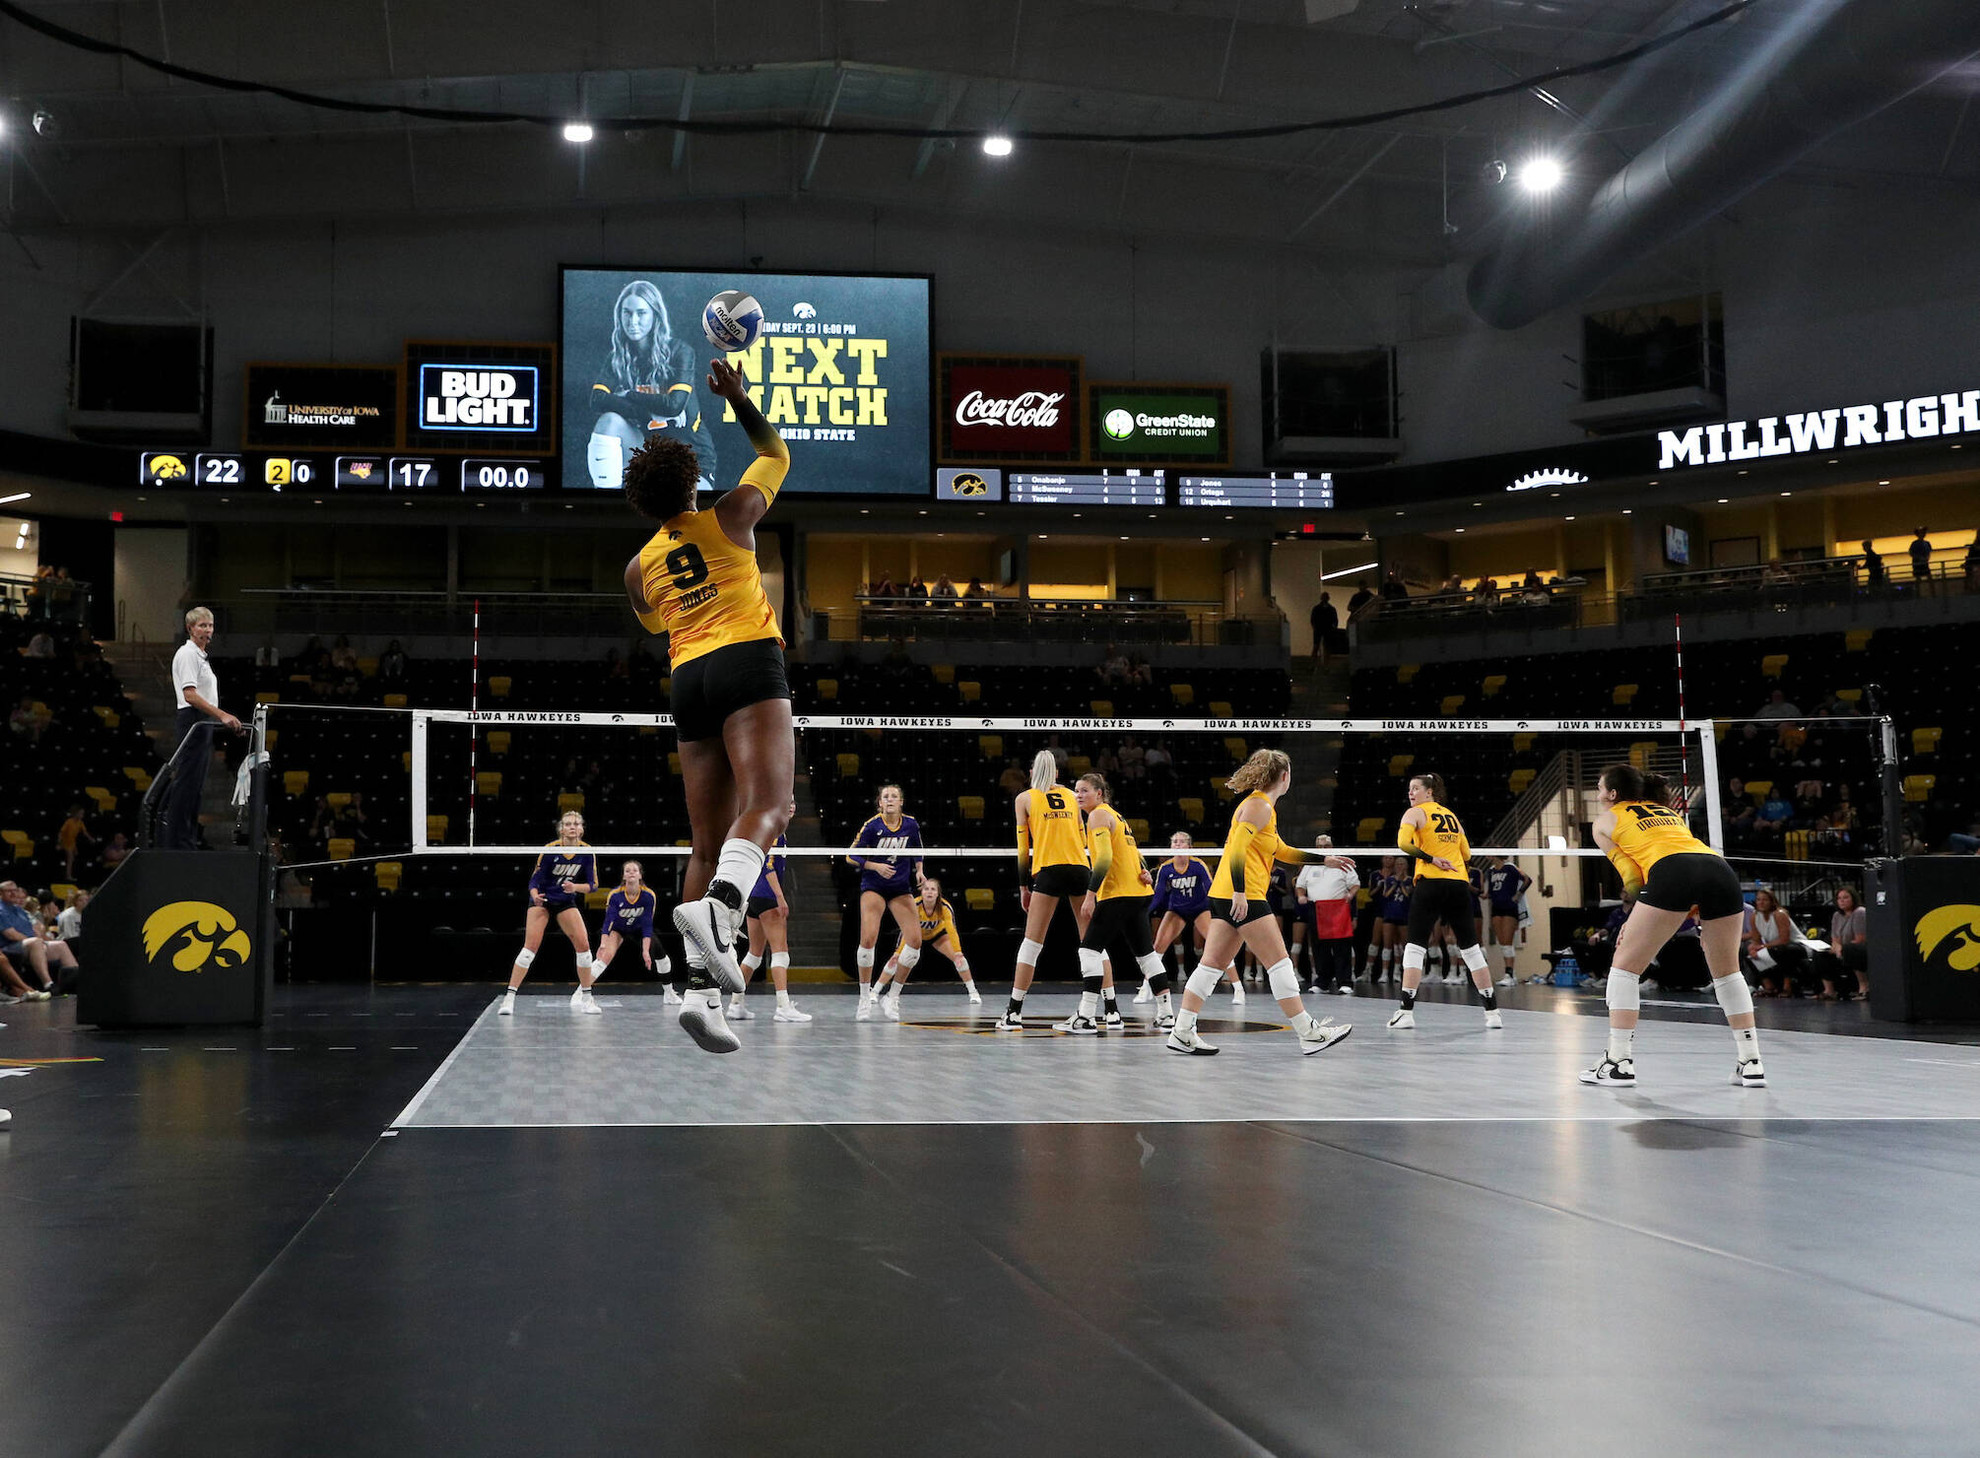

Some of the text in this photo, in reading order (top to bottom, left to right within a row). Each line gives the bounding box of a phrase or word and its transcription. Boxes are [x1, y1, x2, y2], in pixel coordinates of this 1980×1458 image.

[715, 306, 741, 336] molten
[782, 323, 804, 333] SEPT.
[806, 323, 816, 334] 23
[843, 324, 856, 335] PM
[726, 336, 888, 386] NEXT
[441, 371, 517, 399] BUD
[955, 390, 1065, 427] Coca-Cola
[1136, 412, 1216, 428] GreenState
[779, 428, 856, 441] OHIO STATE
[1144, 428, 1208, 437] CREDIT UNION
[1657, 389, 1980, 469] MILLWRIGH
[205, 459, 239, 483] 22
[271, 465, 283, 482] 2
[297, 464, 310, 483] 0
[399, 463, 431, 487] 17
[478, 466, 529, 488] 00.0
[665, 542, 709, 591] 9
[678, 582, 718, 612] JONES
[467, 712, 581, 722] IOWA HAWKEYES
[655, 715, 675, 723] IOW
[840, 717, 952, 727] IOWA HAWKEYES
[1023, 719, 1133, 728] IOWA HAWKEYES
[1203, 720, 1313, 729] IOWA HAWKEYES
[1382, 720, 1489, 730] IOWA HAWKEYES
[1557, 721, 1663, 730] IOWA HAWKEYES
[1045, 793, 1066, 810] 6
[1431, 813, 1459, 834] 20
[552, 863, 582, 877] UNI
[1171, 875, 1197, 889] UNI
[1180, 888, 1193, 898] 11
[618, 907, 645, 918] UNI
